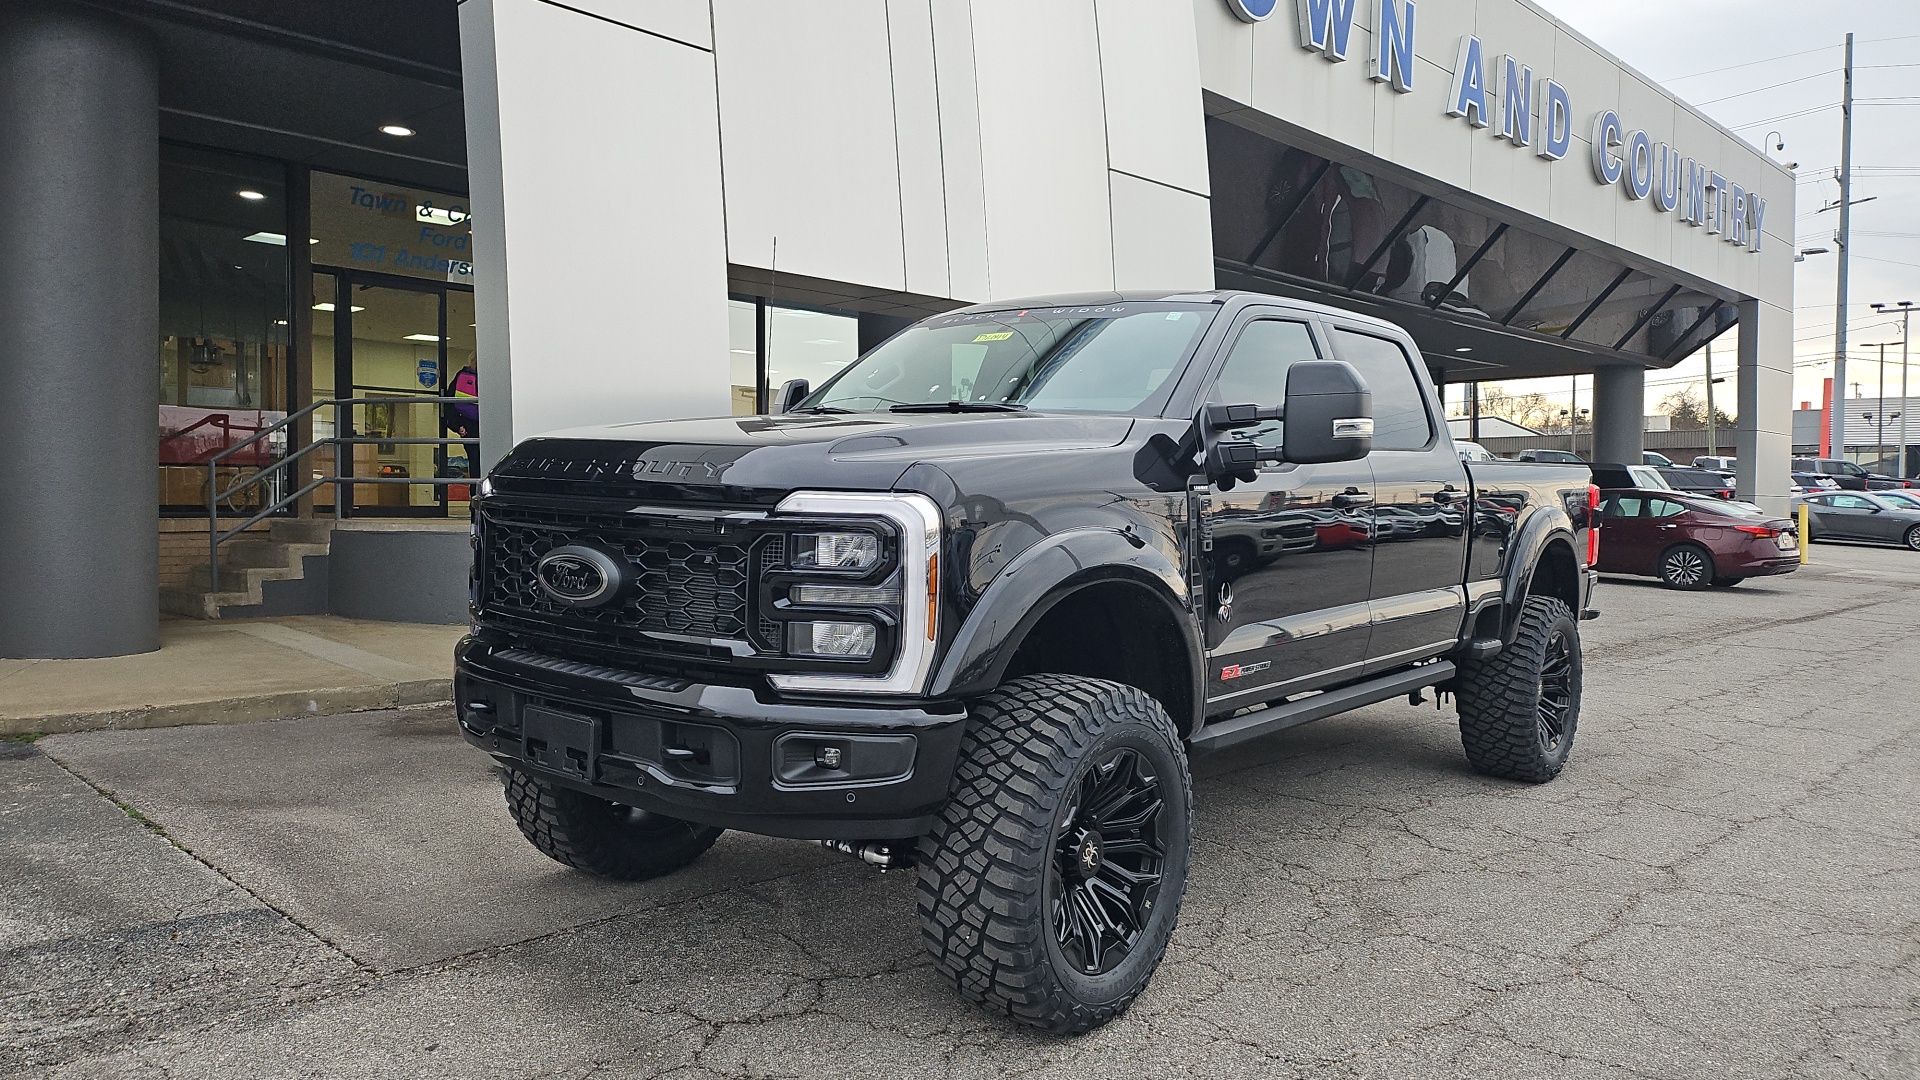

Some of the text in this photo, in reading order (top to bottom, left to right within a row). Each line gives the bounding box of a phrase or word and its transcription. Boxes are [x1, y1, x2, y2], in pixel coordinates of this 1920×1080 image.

[1224, 0, 1767, 252] WN AND COUNTRY
[350, 185, 408, 213] Town
[418, 200, 435, 218] &
[419, 226, 469, 251] Ford
[350, 241, 474, 276] 101 Anders
[1052, 306, 1126, 315] WIDOW
[615, 459, 735, 479] DUTY
[549, 561, 589, 590] Ford
